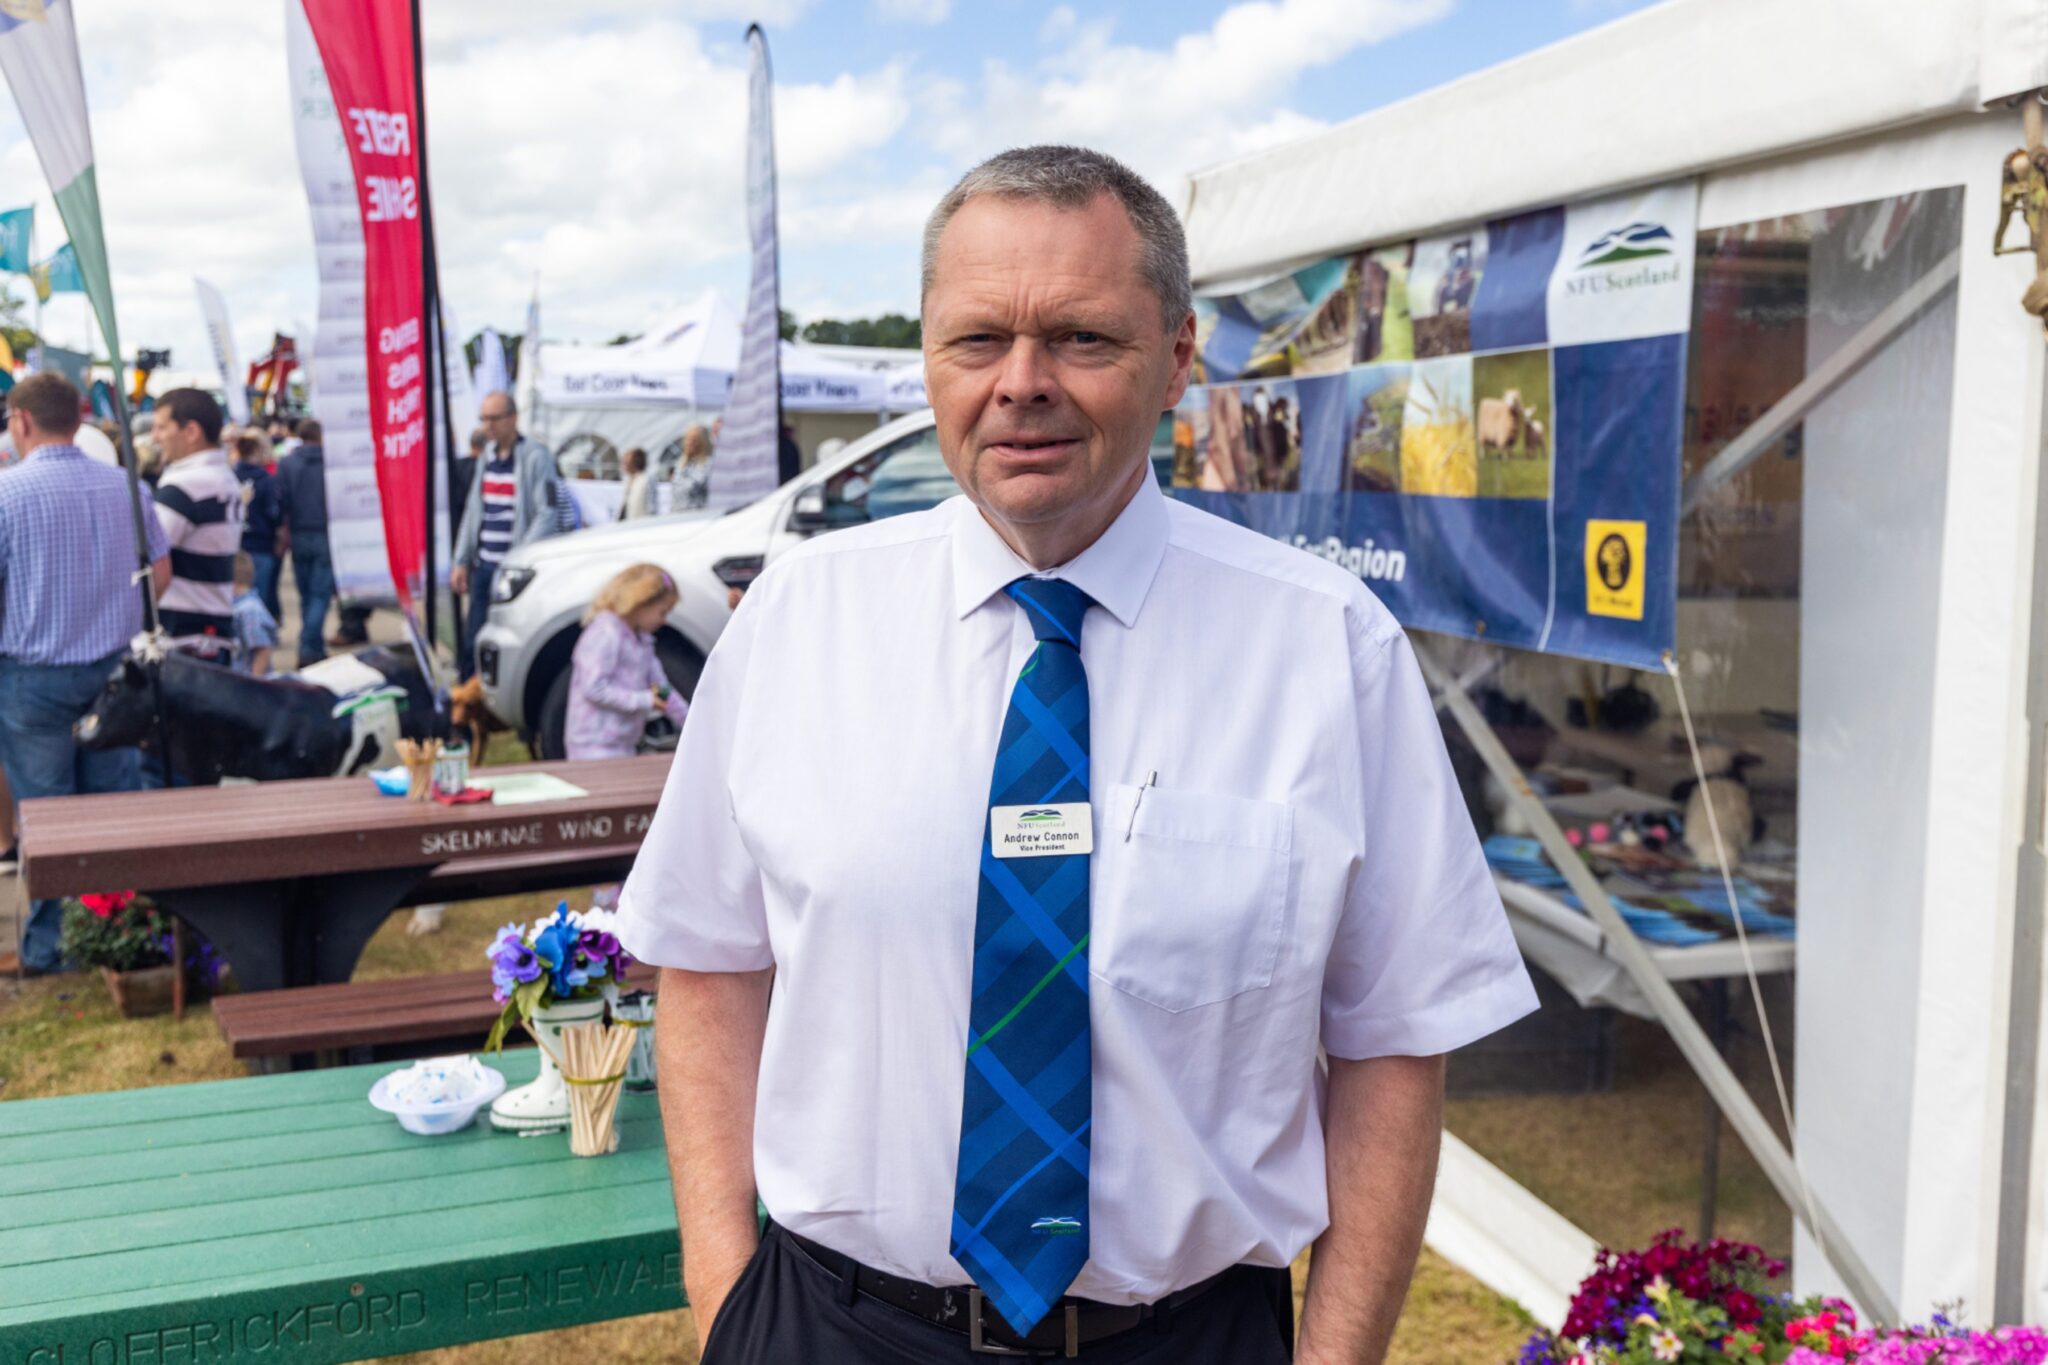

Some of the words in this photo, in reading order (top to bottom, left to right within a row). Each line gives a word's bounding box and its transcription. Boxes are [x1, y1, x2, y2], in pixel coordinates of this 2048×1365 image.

[557, 814, 613, 840] WIND
[1004, 833, 1040, 843] Andrew
[1044, 832, 1080, 841] Connon
